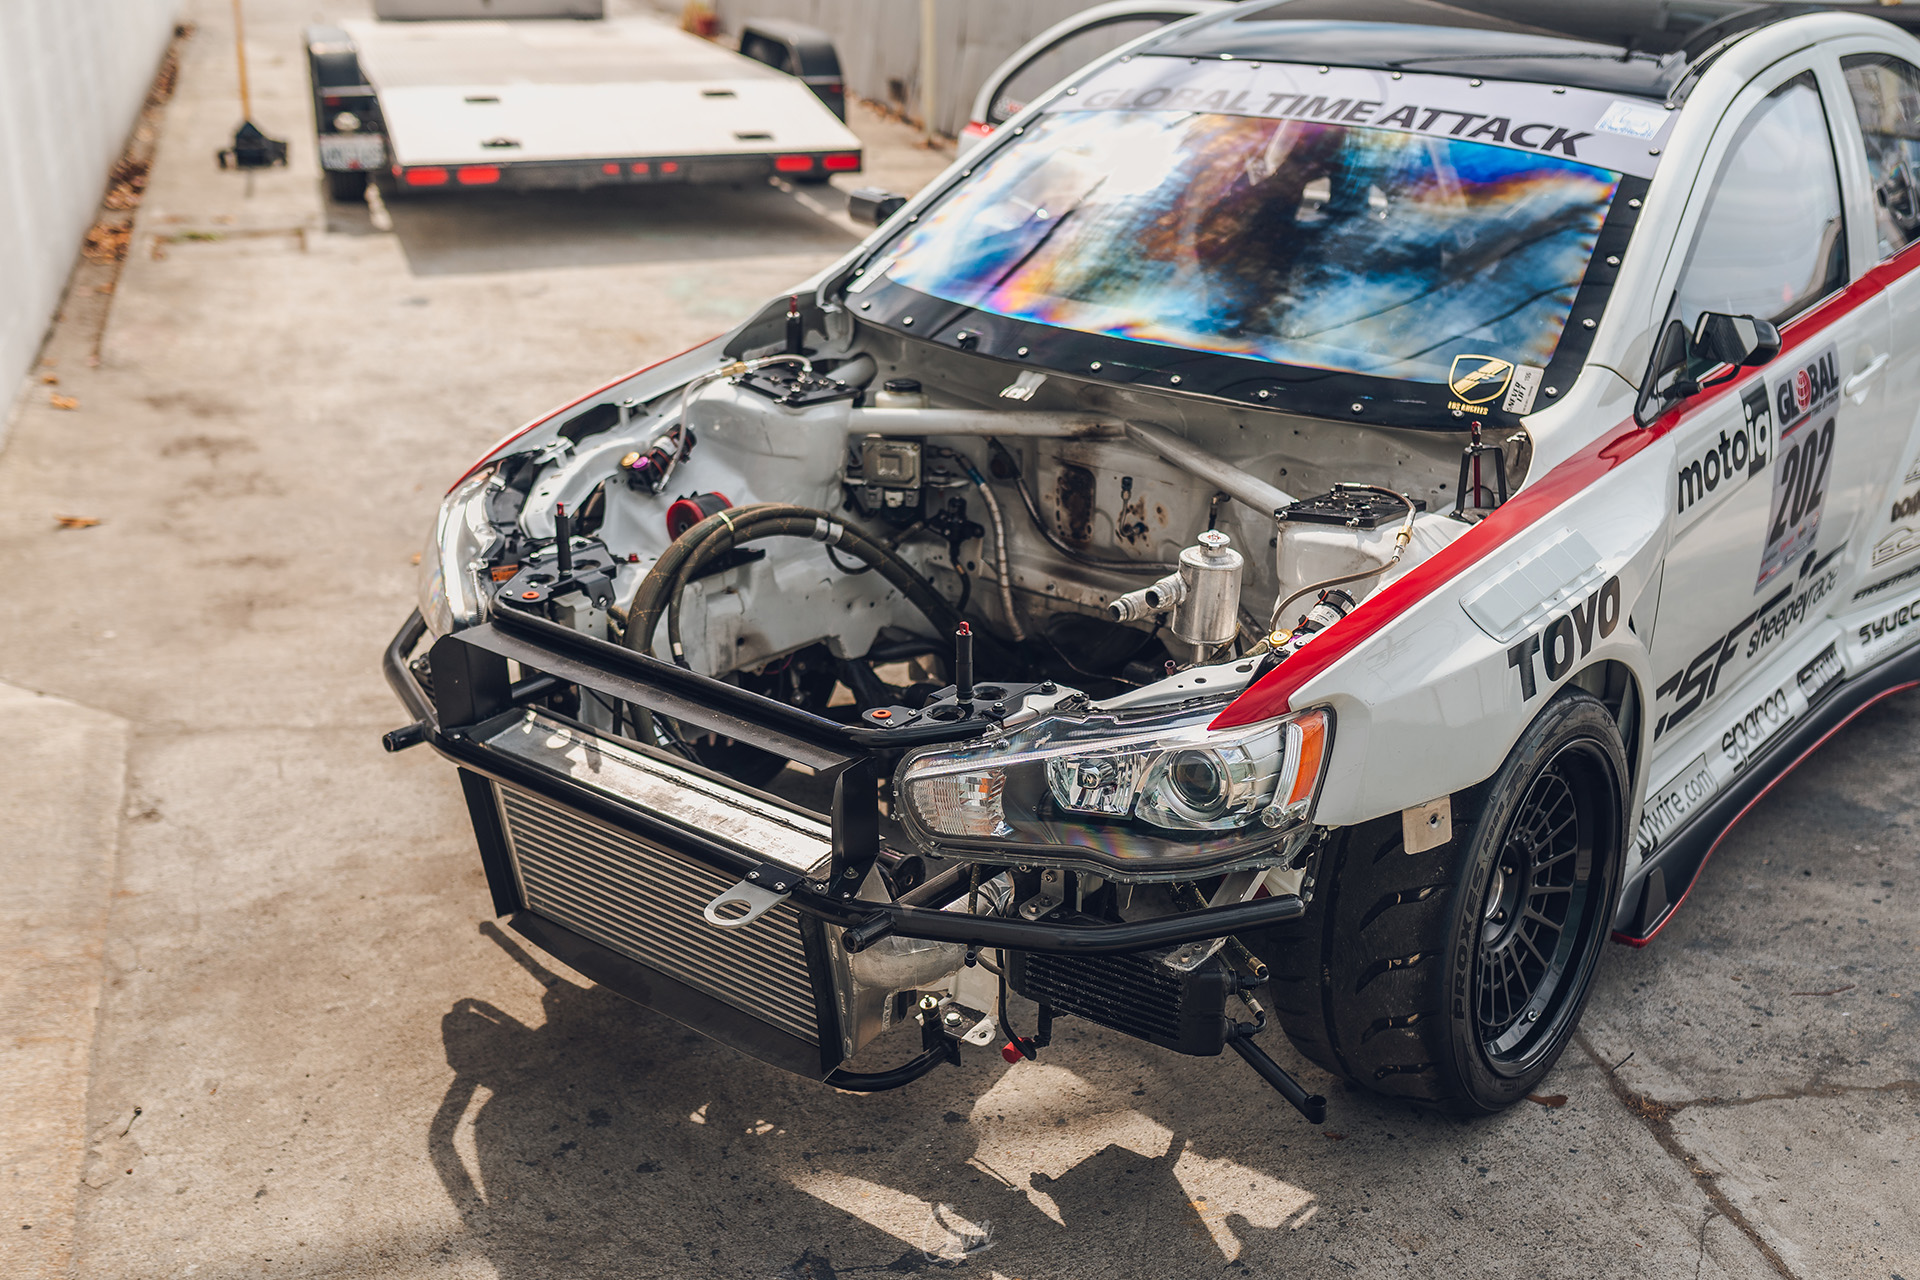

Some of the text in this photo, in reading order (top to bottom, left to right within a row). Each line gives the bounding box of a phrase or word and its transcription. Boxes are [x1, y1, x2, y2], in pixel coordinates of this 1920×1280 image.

[1082, 88, 1248, 110] GLOBAL
[1261, 92, 1383, 123] TIME
[1375, 105, 1594, 157] ATTACK
[1767, 416, 1836, 548] 202
[1506, 574, 1621, 703] TOYO
[1721, 688, 1789, 769] sparco
